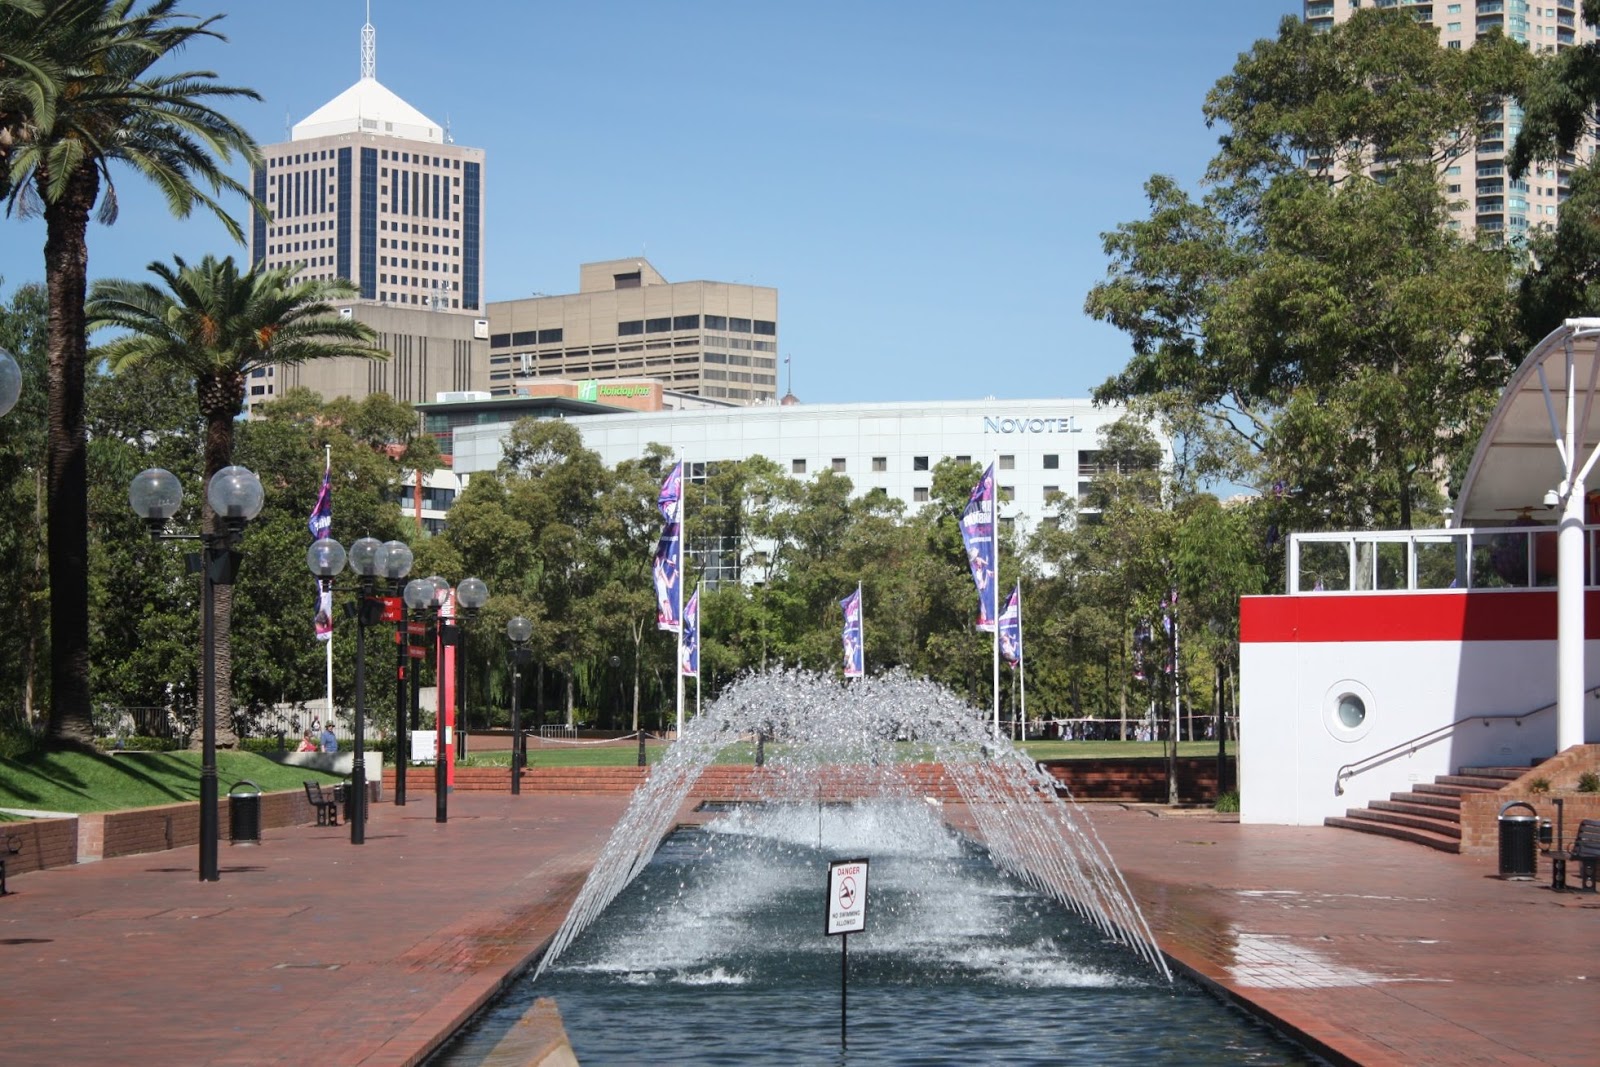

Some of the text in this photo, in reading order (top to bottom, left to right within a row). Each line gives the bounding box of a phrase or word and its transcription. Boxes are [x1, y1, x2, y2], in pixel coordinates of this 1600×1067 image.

[600, 385, 633, 398] Holiday
[634, 384, 650, 396] Inn
[983, 416, 1083, 434] NOVOTEL
[837, 866, 860, 876] DANGER
